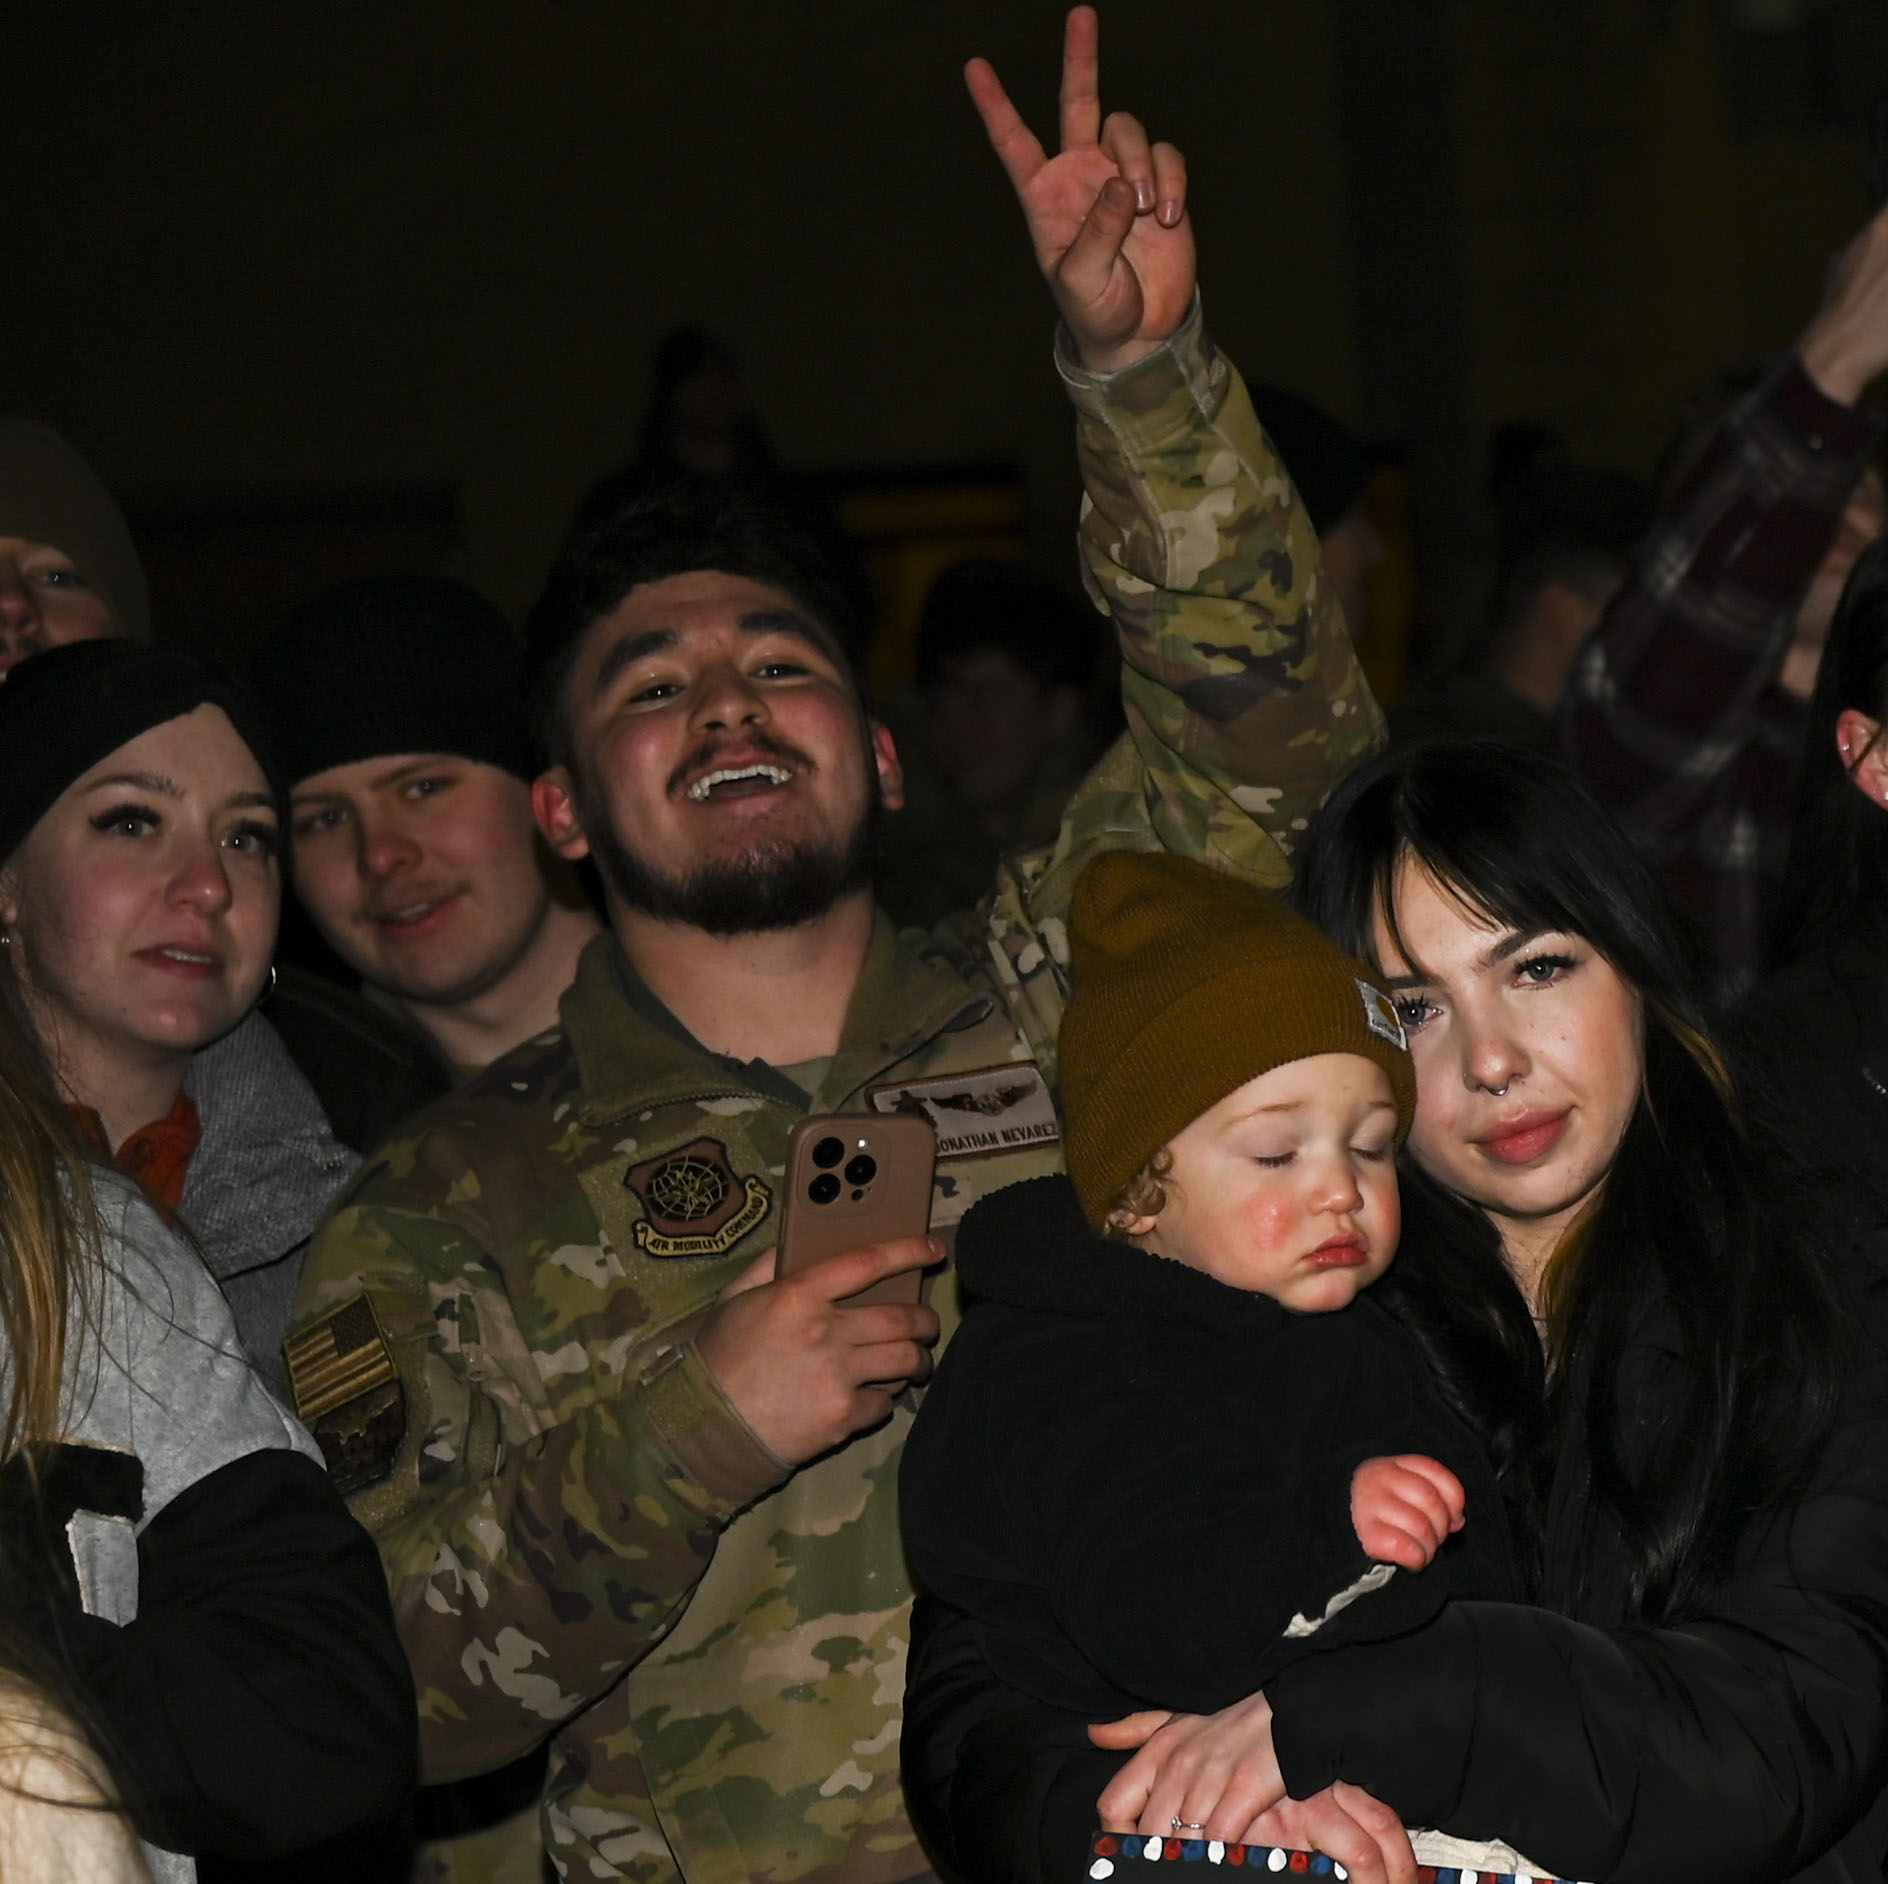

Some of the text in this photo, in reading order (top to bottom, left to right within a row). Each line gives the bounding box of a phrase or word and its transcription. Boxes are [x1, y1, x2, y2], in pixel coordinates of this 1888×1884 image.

[1001, 1123, 1058, 1141] NEVAREZ
[648, 1196, 764, 1251] AIR MOBILITY COMMAND
